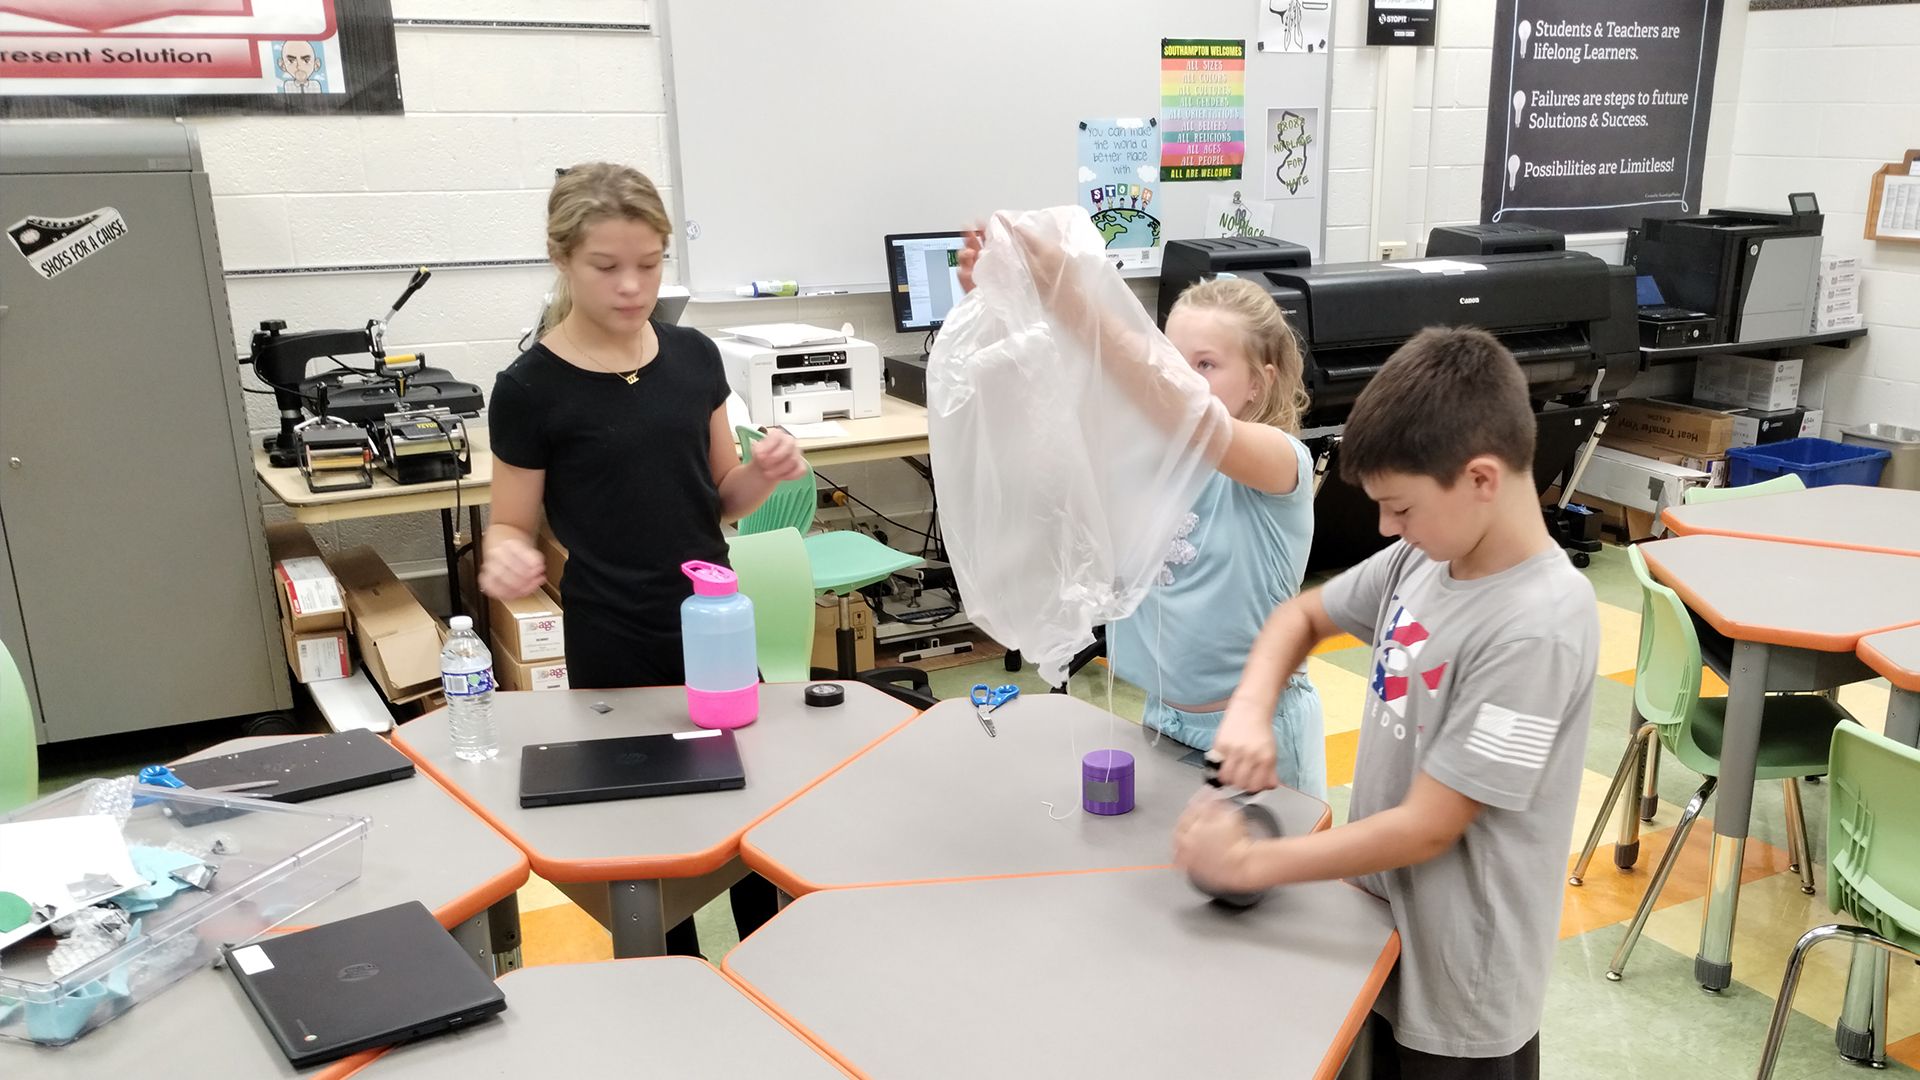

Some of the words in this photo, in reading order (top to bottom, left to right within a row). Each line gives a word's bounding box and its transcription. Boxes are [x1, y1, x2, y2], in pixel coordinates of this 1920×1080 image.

[1535, 20, 1592, 38] Students
[1594, 22, 1603, 38] &
[1606, 22, 1659, 38] Teachers
[1661, 25, 1680, 39] are
[0, 48, 92, 64] resent
[101, 47, 213, 64] Solution
[1164, 45, 1209, 56] SOUTHAMPTON
[1210, 46, 1242, 56] WELCOMES
[1533, 43, 1582, 64] lifelong
[1583, 44, 1639, 60] Learners.
[1186, 60, 1199, 71] ALL
[1202, 60, 1224, 71] SIZES
[1183, 73, 1196, 83] ALL
[1530, 89, 1580, 107] Failures
[1582, 94, 1601, 106] are
[1603, 92, 1635, 109] steps
[1637, 91, 1650, 106] to
[1651, 88, 1689, 105] future
[1182, 121, 1195, 131] ALL
[1528, 112, 1588, 129] Solutions
[1589, 112, 1599, 128] &
[1601, 111, 1649, 128] Success.
[1107, 127, 1126, 137] can
[1178, 133, 1191, 143] ALL
[1194, 132, 1232, 142] RELIGIONS
[1095, 139, 1109, 150] the
[1113, 139, 1138, 149] world
[1141, 139, 1148, 149] a
[1186, 144, 1199, 154] ALL
[1203, 143, 1222, 153] AGES
[1093, 152, 1121, 163] better
[1181, 156, 1194, 166] ALL
[1198, 155, 1224, 166] PEOPLE
[1287, 157, 1303, 169] FOR
[1170, 169, 1183, 178] ALL
[1185, 169, 1199, 178] ARE
[1201, 168, 1232, 178] WELCOME
[1523, 159, 1597, 178] Possibilities
[1598, 161, 1618, 175] are
[1619, 157, 1675, 174] Limitless!
[41, 250, 73, 277] SHOES
[68, 239, 92, 261] FOR
[88, 235, 100, 250] A
[95, 219, 127, 245] CAUSE
[1641, 423, 1675, 438] Transfer
[1678, 431, 1699, 443] Heat
[538, 620, 556, 632] agc
[549, 667, 567, 679] agc
